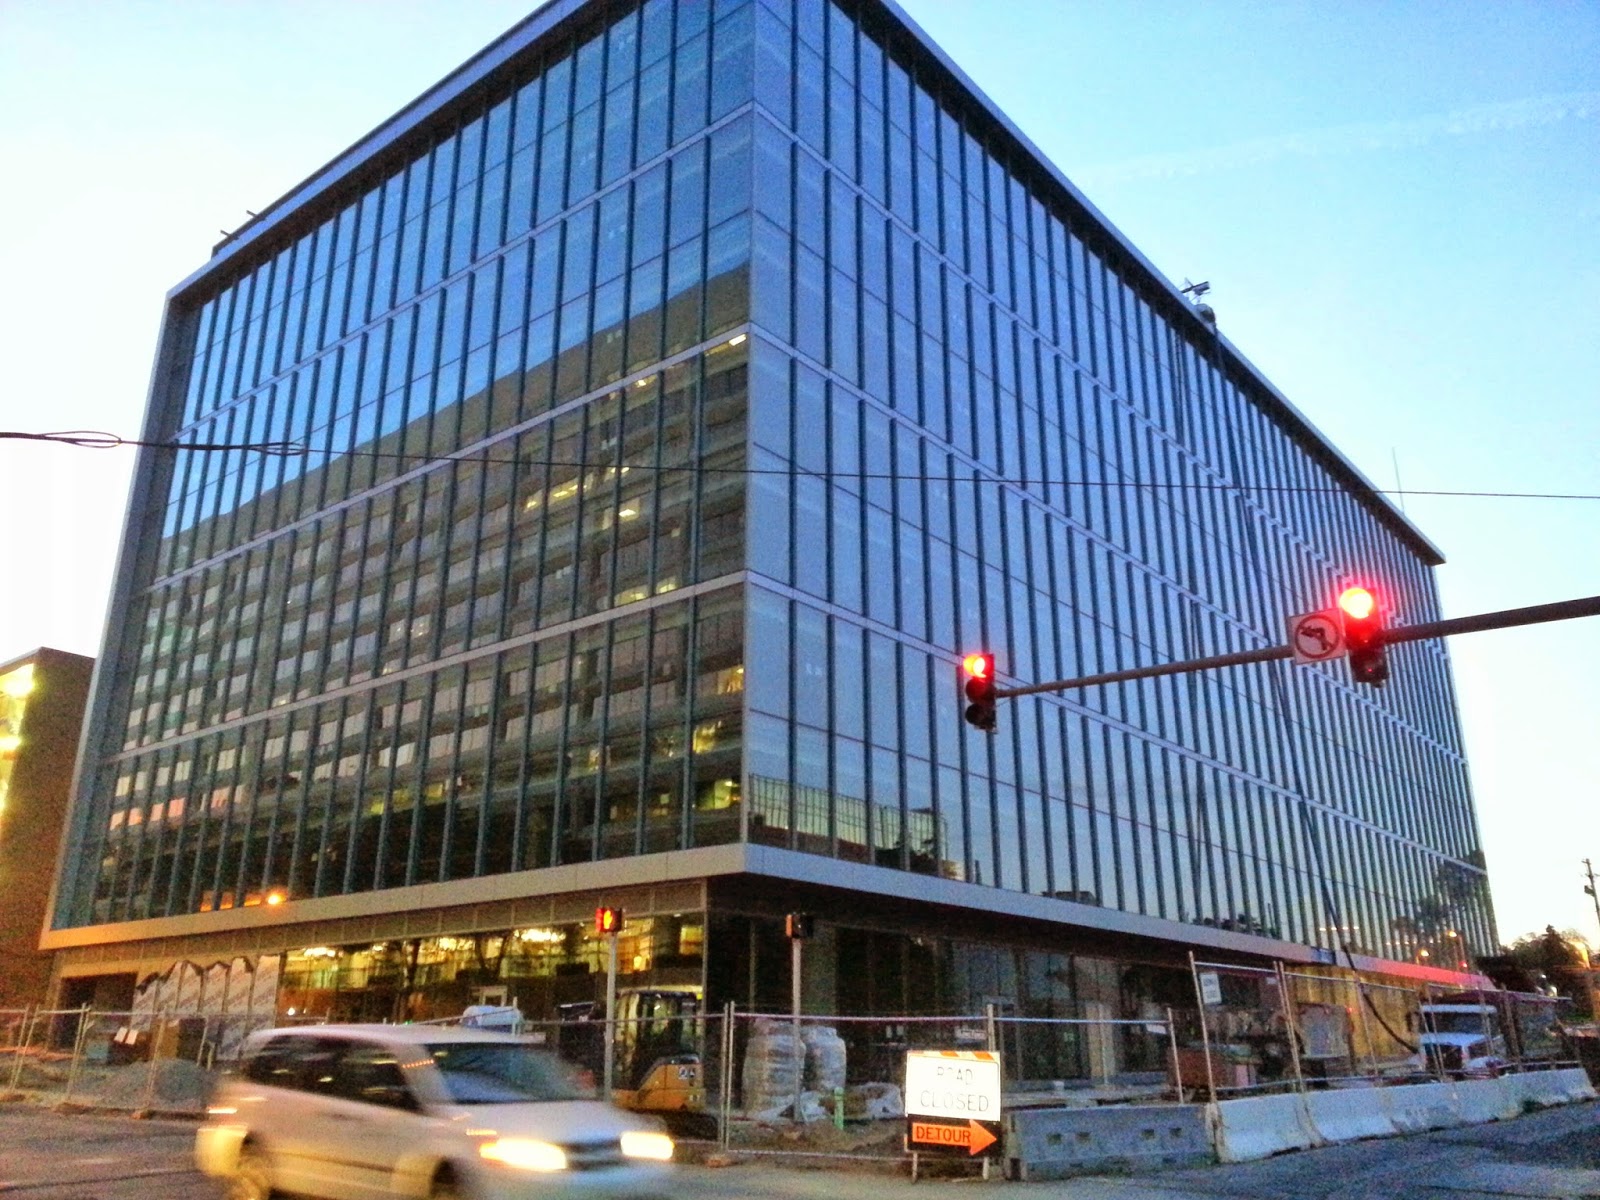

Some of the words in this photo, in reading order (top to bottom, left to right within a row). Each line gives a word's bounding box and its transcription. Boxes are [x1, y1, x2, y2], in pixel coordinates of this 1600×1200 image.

[937, 1066, 974, 1086] RAD
[920, 1089, 989, 1112] CLOSED
[916, 1125, 971, 1143] DETOUR
